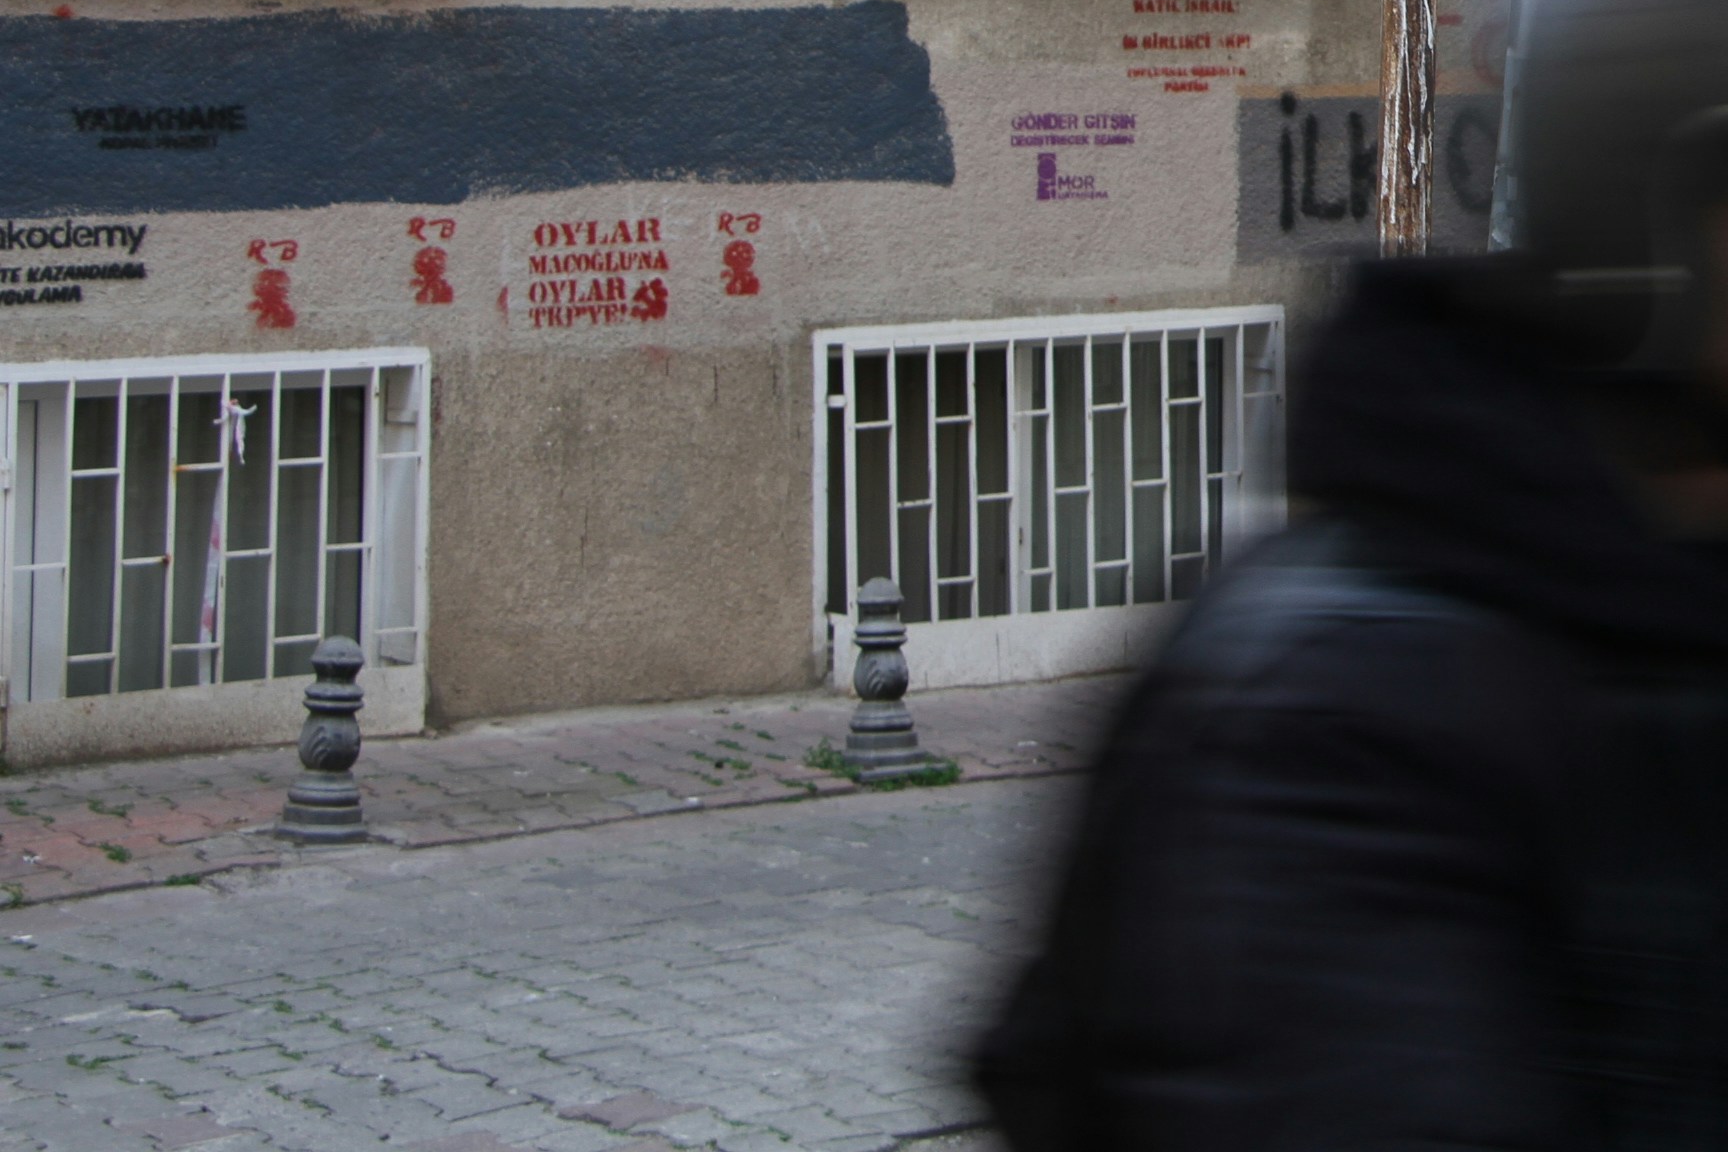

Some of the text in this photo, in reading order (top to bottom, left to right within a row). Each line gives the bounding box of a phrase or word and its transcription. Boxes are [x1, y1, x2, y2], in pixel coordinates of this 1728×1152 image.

[1057, 174, 1096, 190] MOR
[533, 217, 662, 247] OYLAR
[528, 276, 626, 305] OYLAR
